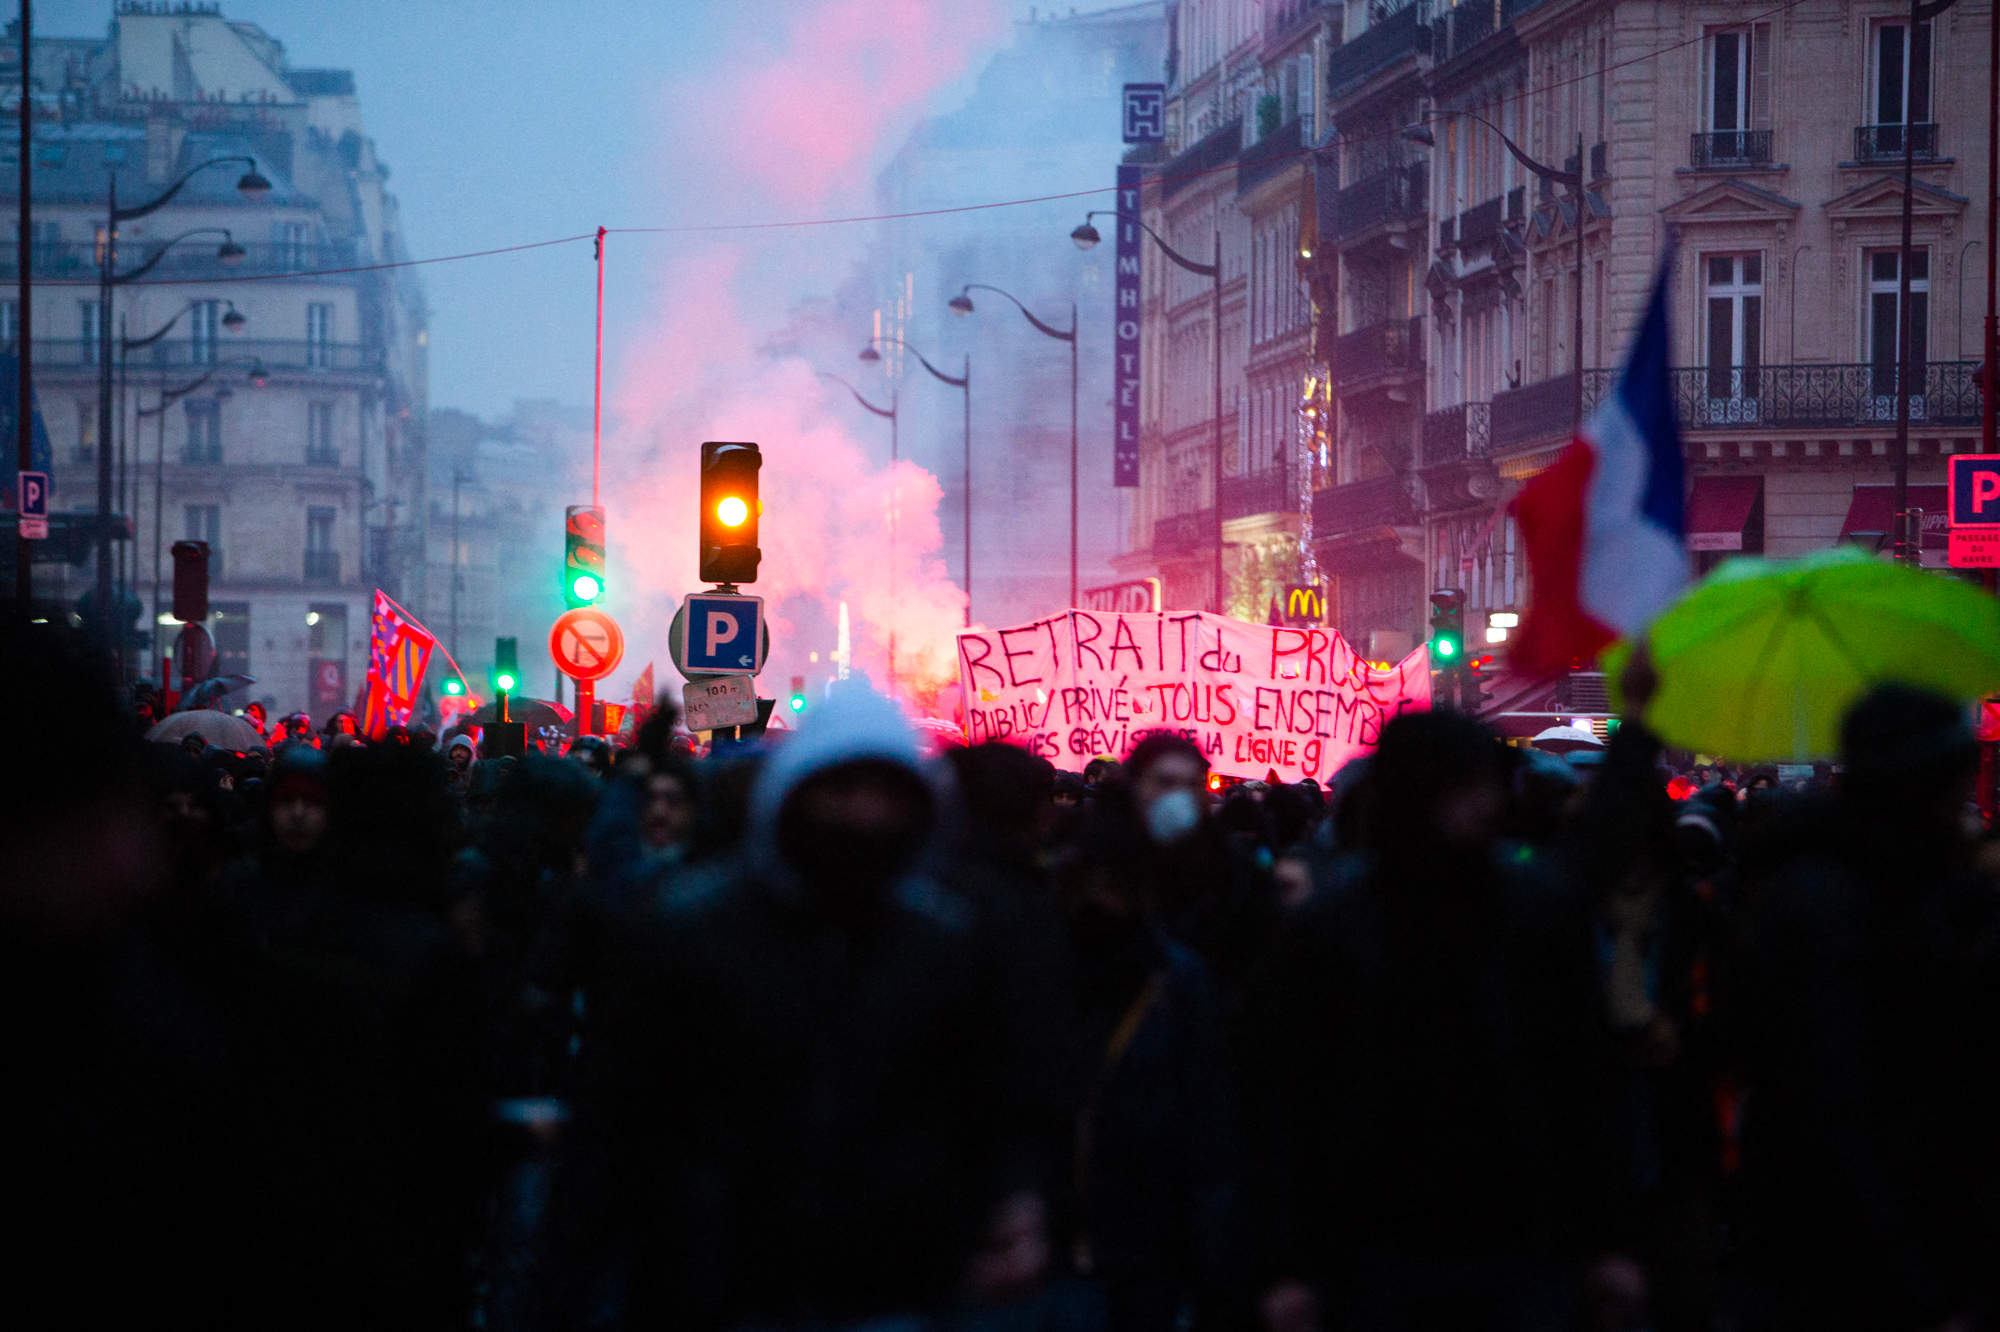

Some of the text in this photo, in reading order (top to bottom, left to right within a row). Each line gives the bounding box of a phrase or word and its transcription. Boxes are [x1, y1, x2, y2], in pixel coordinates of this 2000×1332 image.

[27, 481, 41, 509] P
[1972, 471, 2000, 514] P
[1956, 534, 1999, 542] PASSAGE
[1971, 545, 1984, 553] DU
[1961, 555, 1994, 563] HAVRE
[706, 611, 739, 657] P
[1200, 628, 1240, 673] du
[706, 685, 727, 697] 100
[1146, 681, 1236, 726] TOUS
[1255, 687, 1412, 745] ENSEMB
[1028, 731, 1060, 758] ES
[1206, 732, 1223, 755] LA
